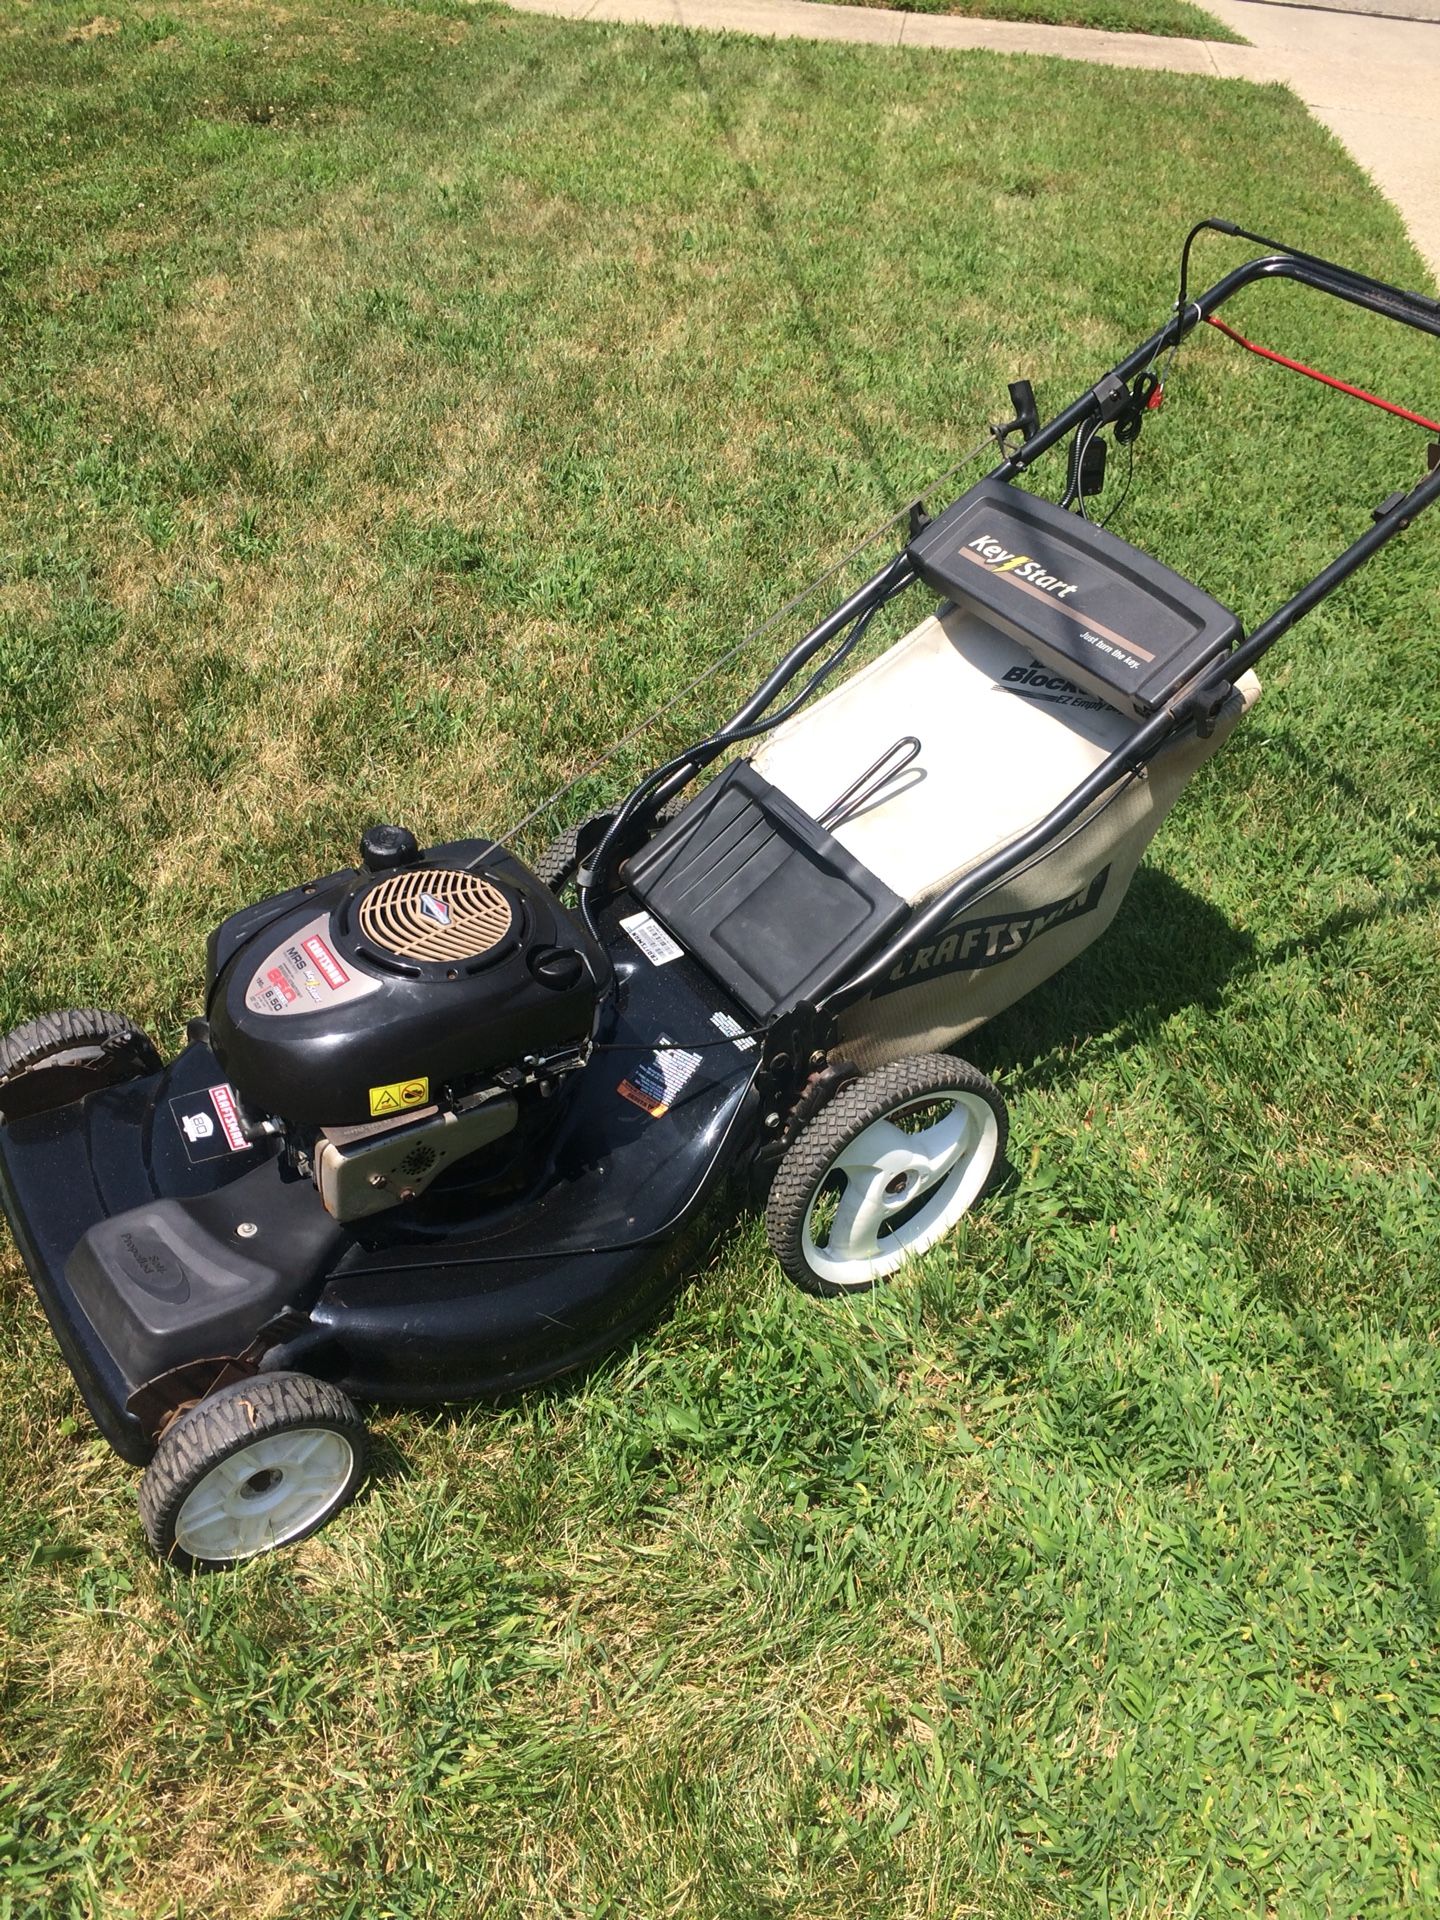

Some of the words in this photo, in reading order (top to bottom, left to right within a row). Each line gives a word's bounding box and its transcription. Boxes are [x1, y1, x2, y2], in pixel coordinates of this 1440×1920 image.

[968, 535, 1014, 564] Key
[1014, 560, 1079, 598] Start
[1080, 631, 1096, 645] Just
[1096, 640, 1112, 654] turn
[1112, 648, 1124, 660] the
[1123, 656, 1142, 670] key.
[1056, 695, 1073, 704] EZ
[1070, 698, 1107, 711] Empty
[286, 946, 307, 970] MRS
[265, 990, 283, 1012] 6.50
[215, 1089, 247, 1147] CRAFTSMAN
